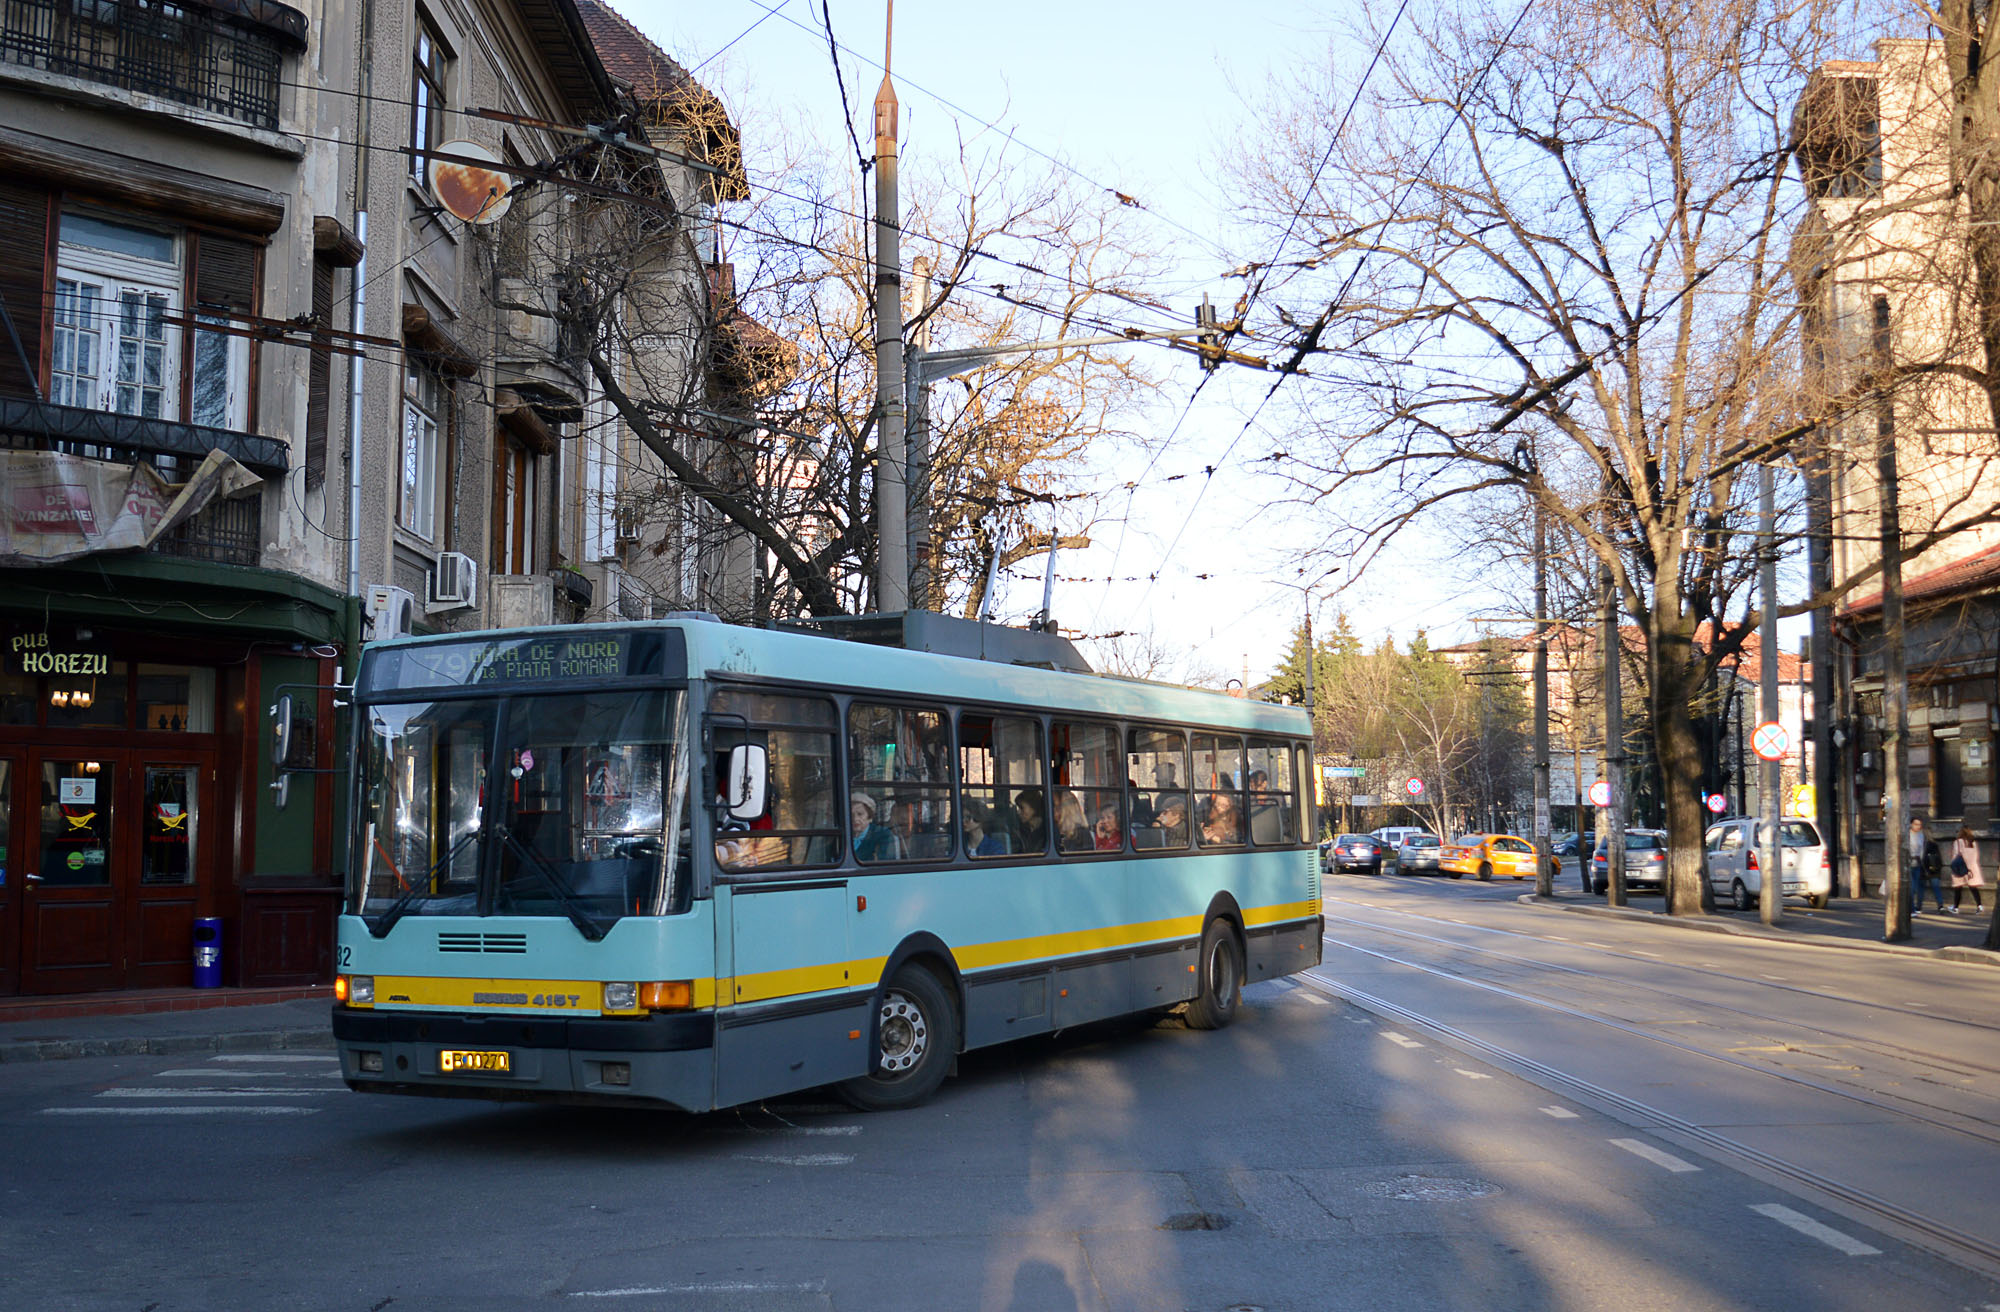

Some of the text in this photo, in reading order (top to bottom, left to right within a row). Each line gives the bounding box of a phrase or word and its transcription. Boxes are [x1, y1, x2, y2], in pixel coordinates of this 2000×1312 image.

[45, 495, 66, 506] DE
[11, 632, 49, 652] PUB
[530, 644, 555, 661] DE
[567, 641, 620, 659] NORD
[23, 652, 108, 675] HOREZU
[423, 653, 467, 679] 79
[506, 661, 551, 678] PIATA
[560, 657, 619, 676] ROMANA
